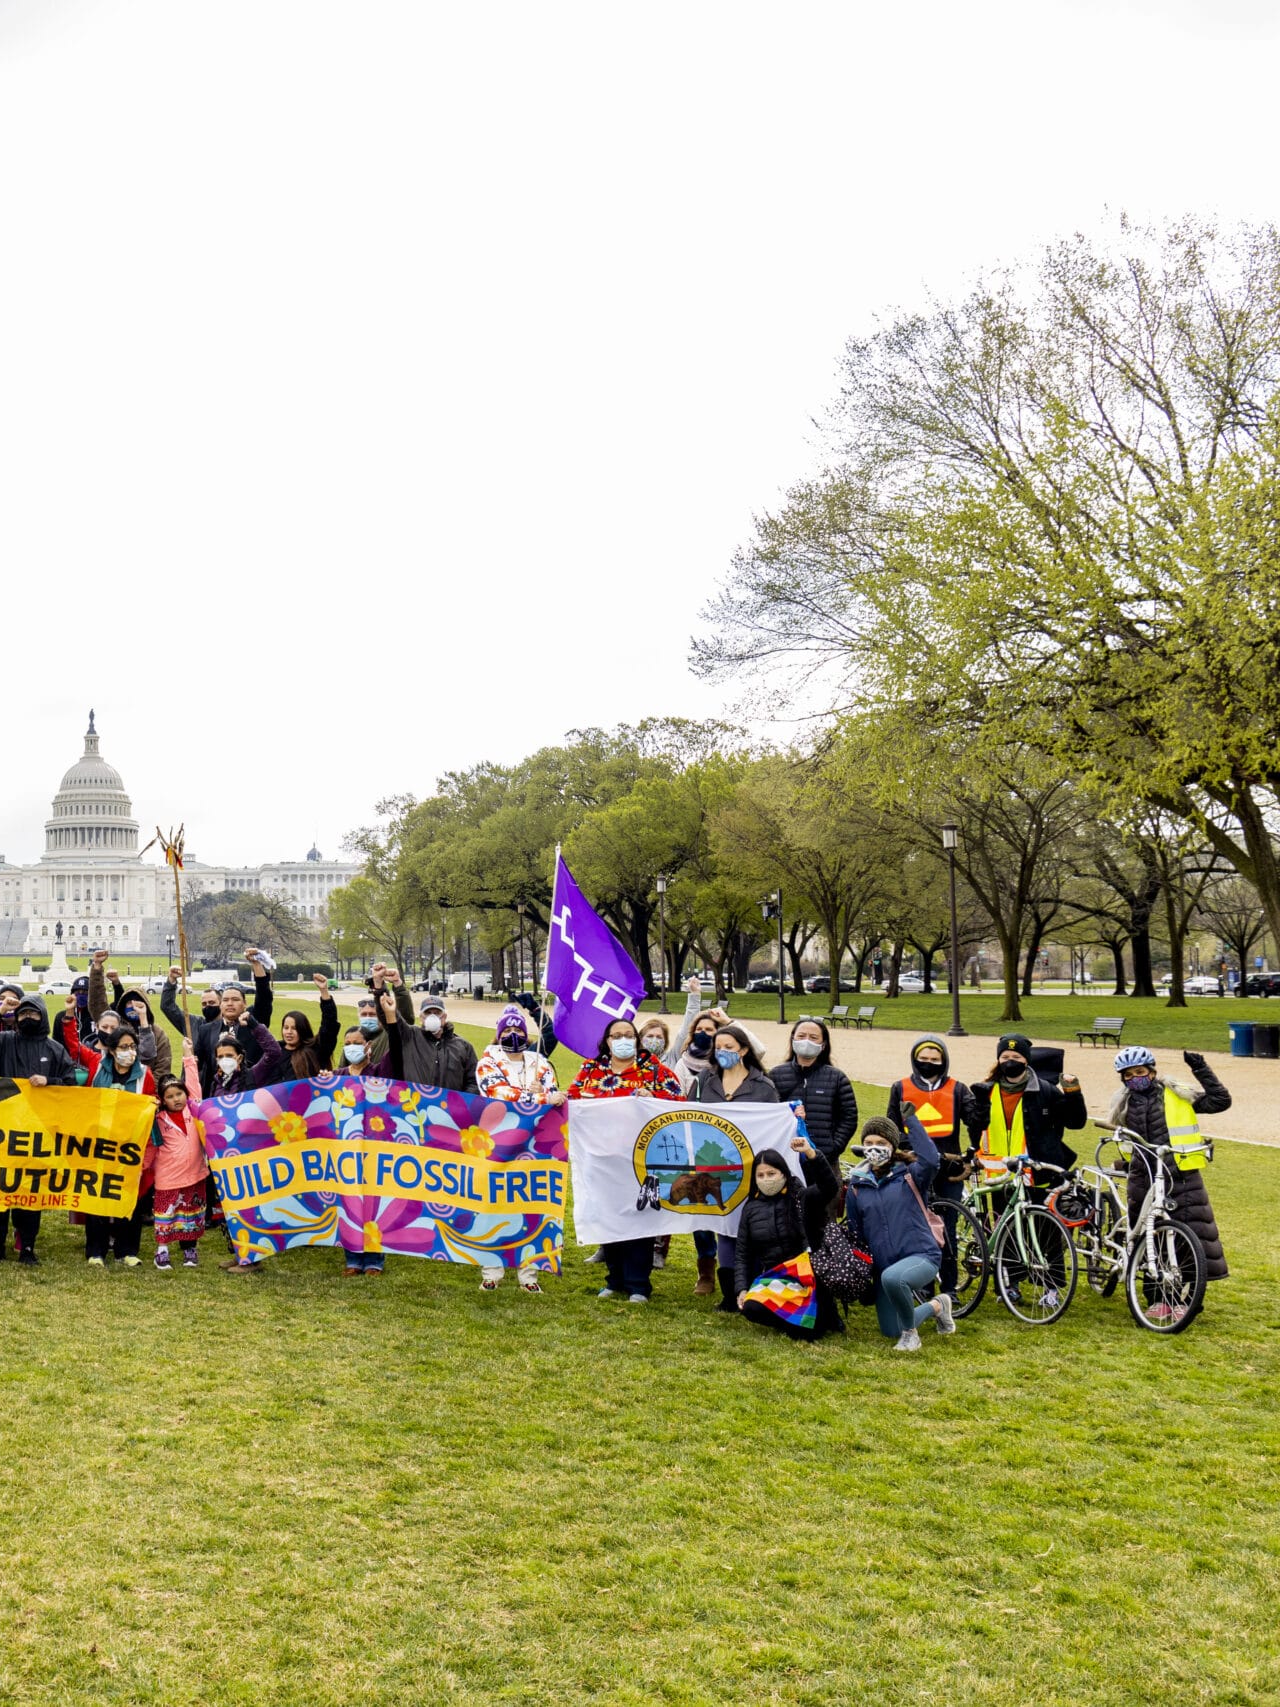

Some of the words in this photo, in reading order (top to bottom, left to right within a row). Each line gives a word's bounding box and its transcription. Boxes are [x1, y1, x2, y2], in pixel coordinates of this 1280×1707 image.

[637, 1114, 674, 1151] MONACAN
[676, 1112, 712, 1123] INDIAN
[714, 1119, 747, 1150] NATION
[376, 1153, 482, 1201] FOSSIL
[489, 1170, 562, 1205] FREE
[41, 1194, 68, 1206] LINE
[71, 1195, 81, 1208] 3
